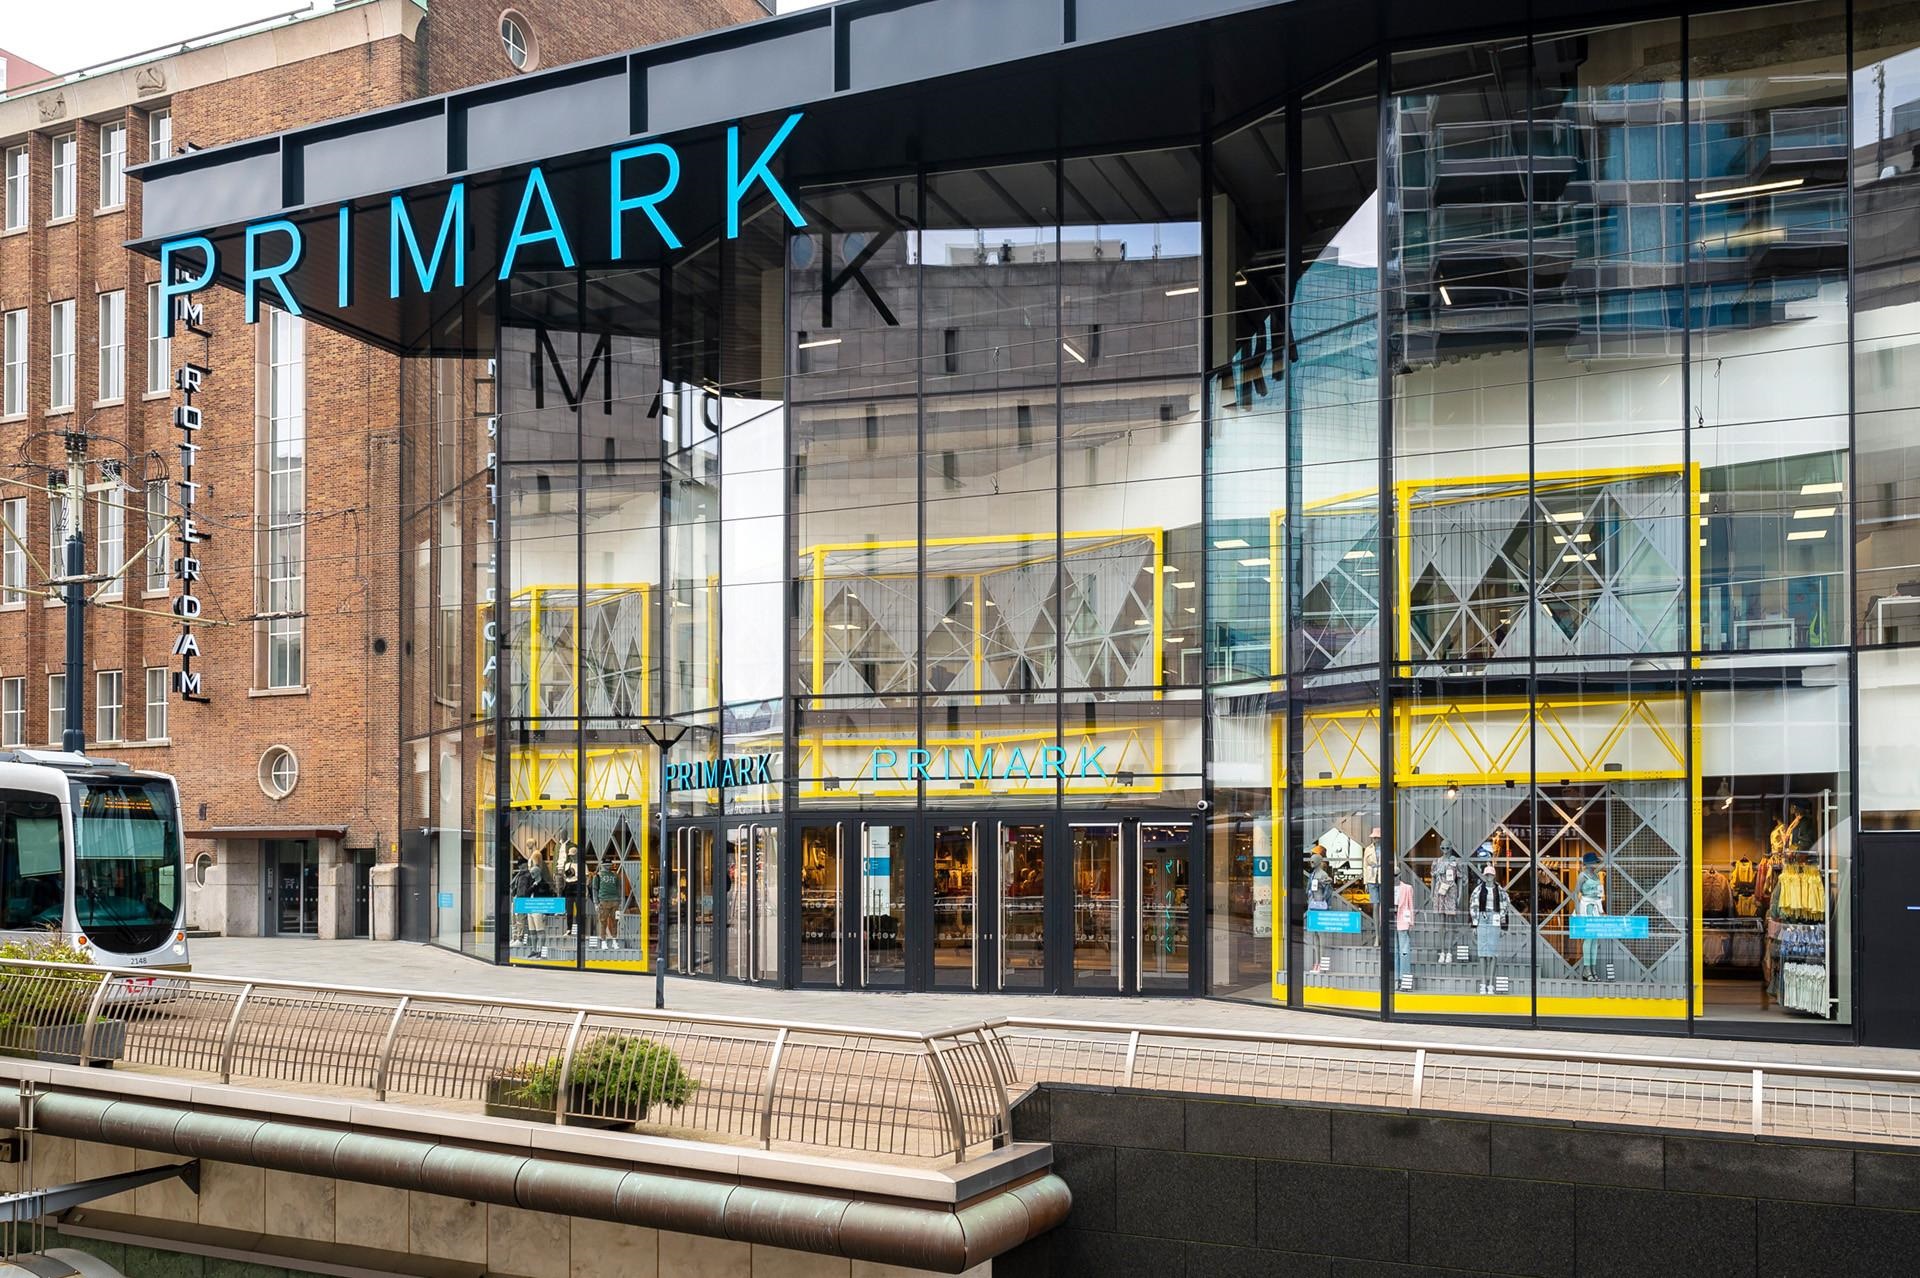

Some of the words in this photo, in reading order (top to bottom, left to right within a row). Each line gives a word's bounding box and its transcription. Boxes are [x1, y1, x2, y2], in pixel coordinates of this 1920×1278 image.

[158, 112, 808, 338] PRIMARK
[179, 366, 202, 694] ROTTERDAM
[665, 753, 771, 792] PRIMARK
[872, 744, 1107, 781] PRIMARK
[130, 957, 148, 965] 2148
